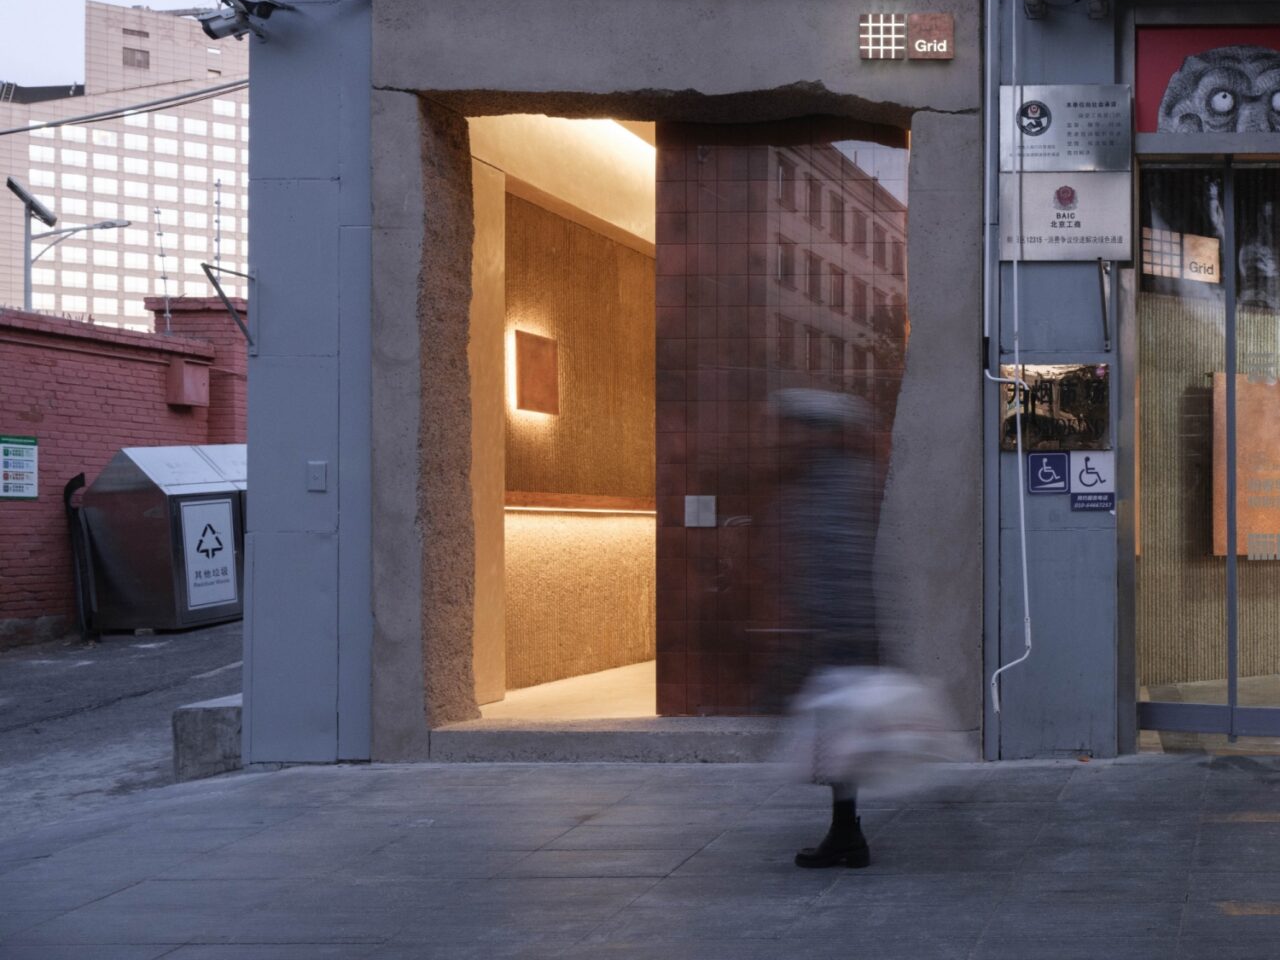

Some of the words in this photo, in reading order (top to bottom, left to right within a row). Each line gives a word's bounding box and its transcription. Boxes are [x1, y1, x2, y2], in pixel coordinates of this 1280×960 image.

[914, 39, 948, 52] Grid
[1056, 212, 1076, 220] BAIC
[1188, 260, 1214, 276] Grid
